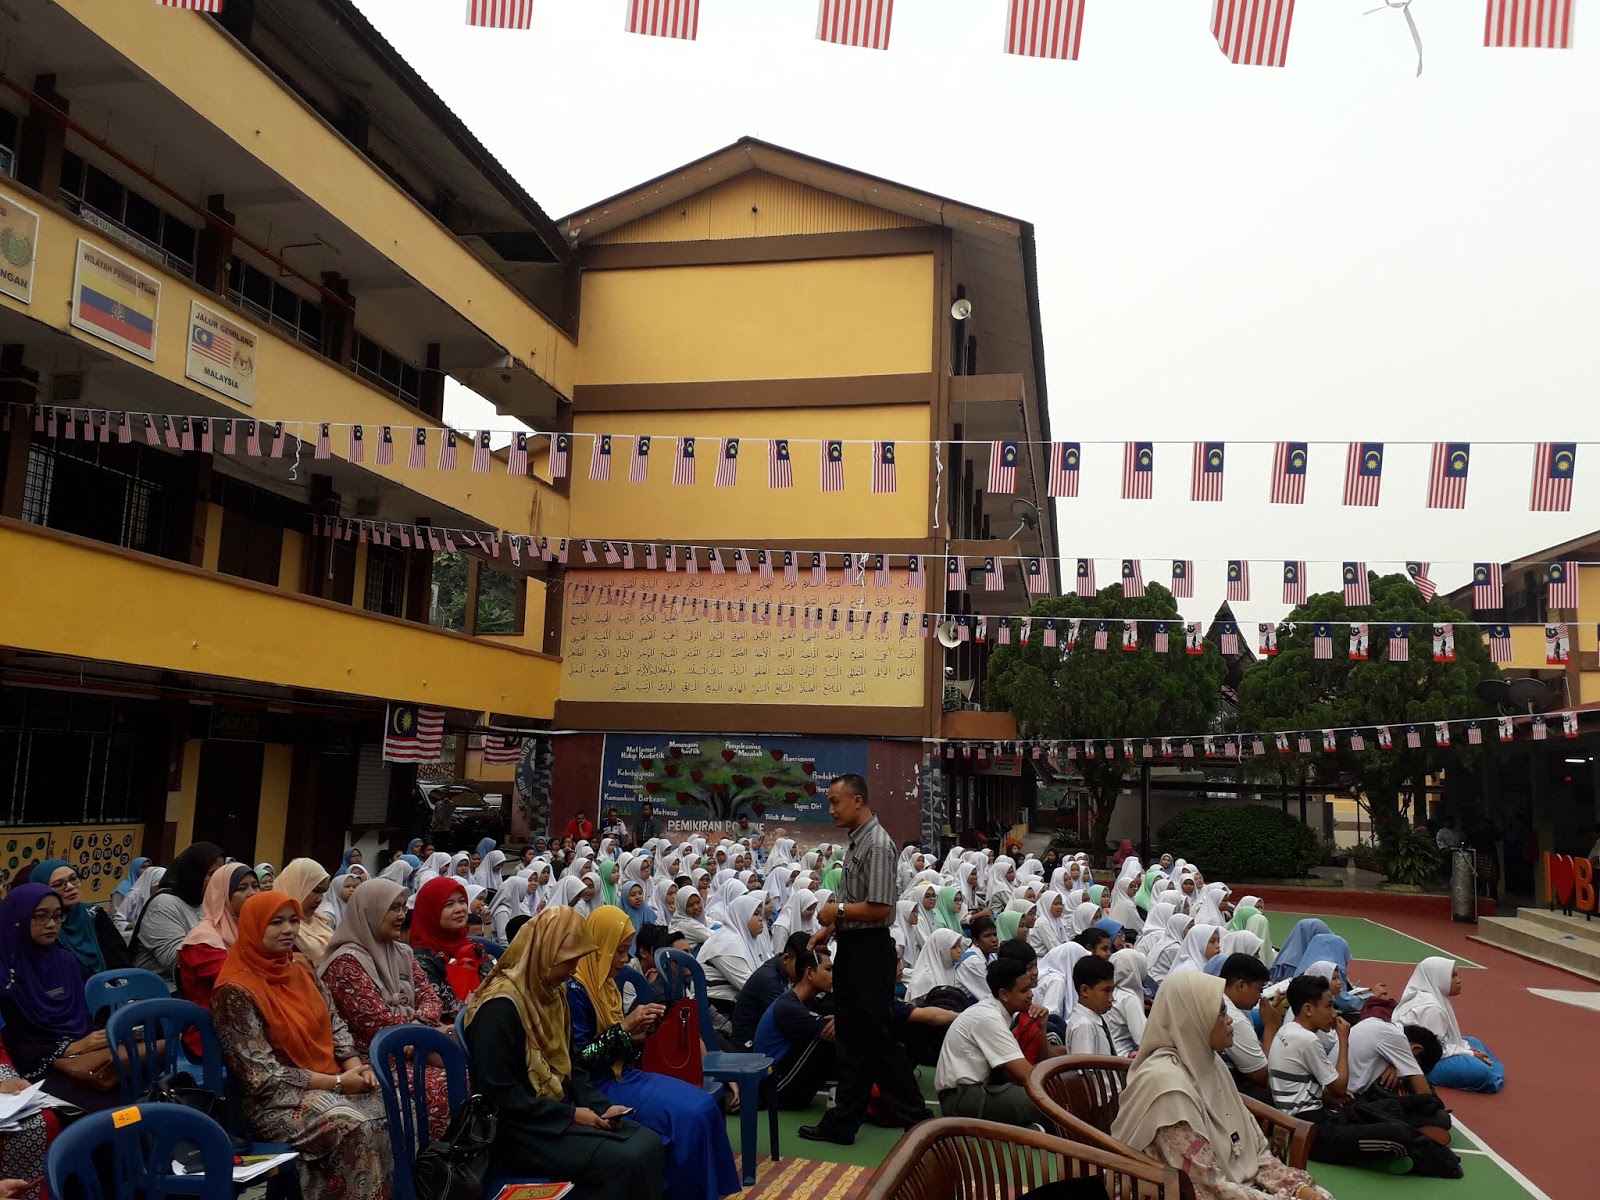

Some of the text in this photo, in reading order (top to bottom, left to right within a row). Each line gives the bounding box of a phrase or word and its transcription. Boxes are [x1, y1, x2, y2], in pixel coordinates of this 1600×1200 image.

[83, 252, 157, 297] WILAYAH PERSEKUTUAN
[195, 311, 254, 348] JALUR GEMILANG
[203, 366, 239, 389] MALAYSIA
[652, 807, 679, 816] Motivasi
[810, 801, 822, 810] Diri
[667, 820, 722, 832] PEMIKIRAN
